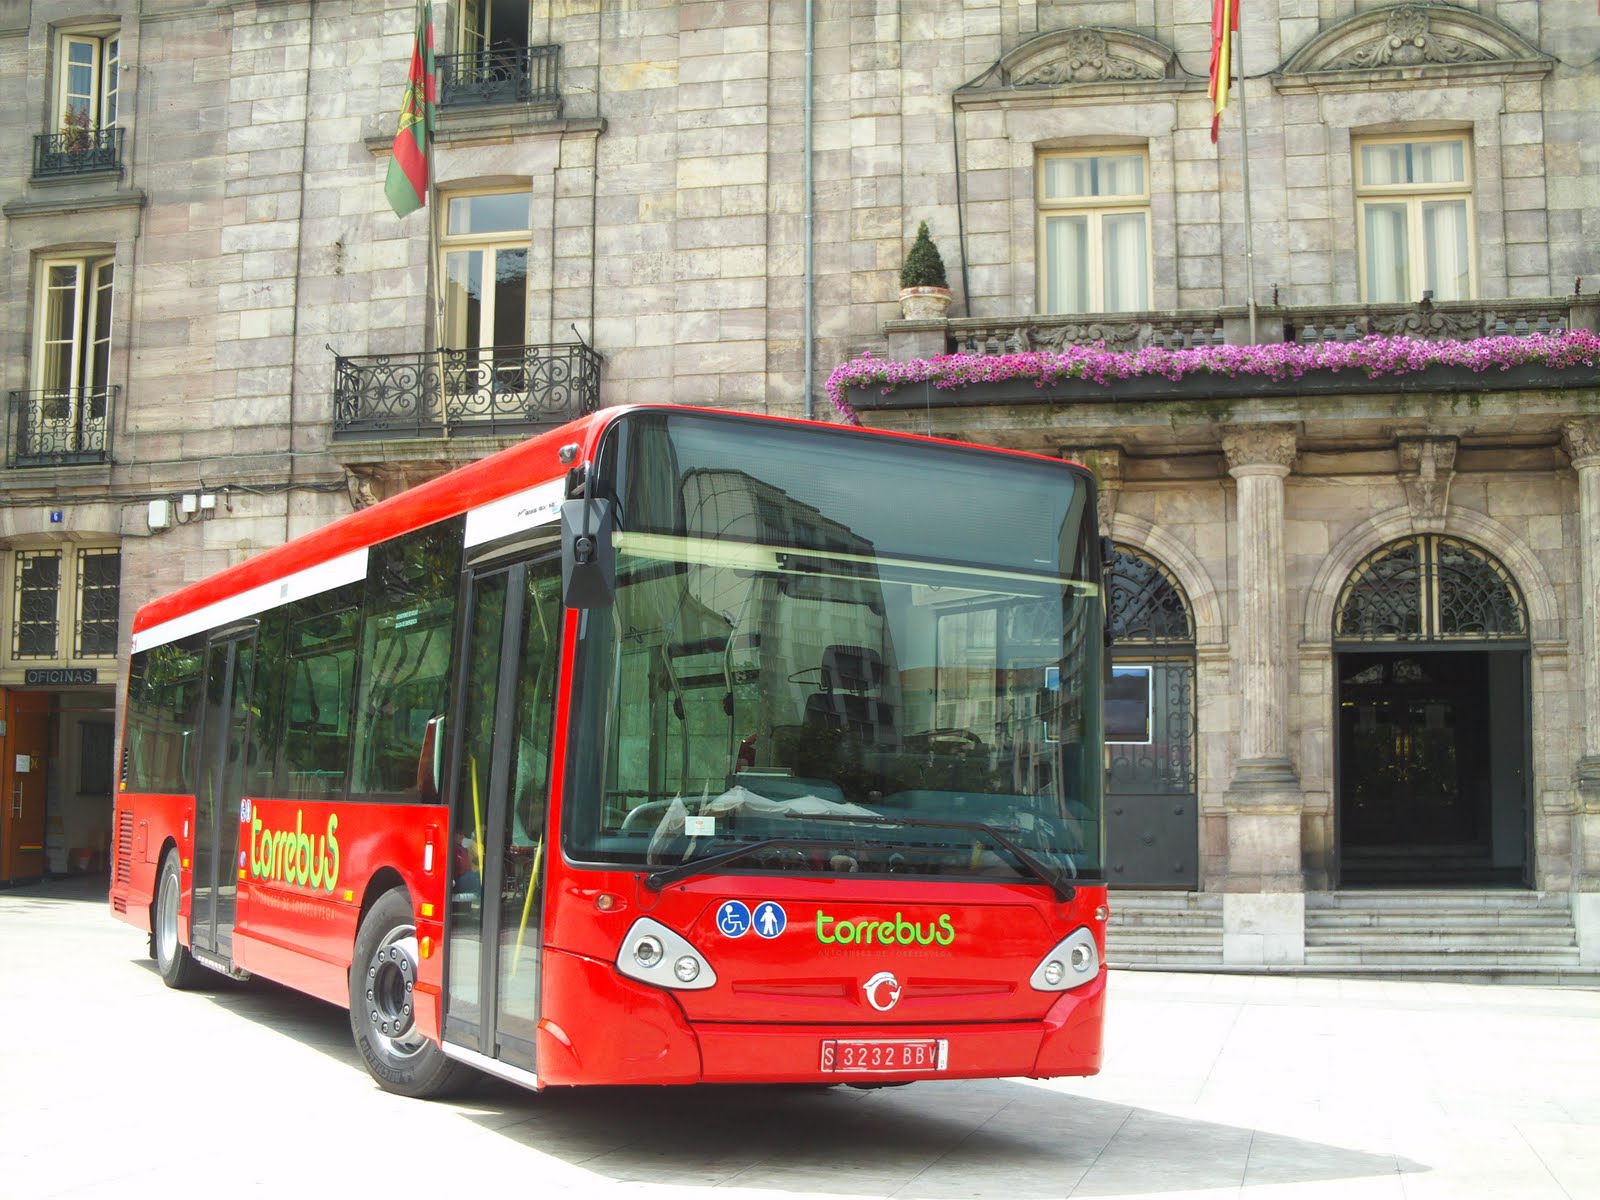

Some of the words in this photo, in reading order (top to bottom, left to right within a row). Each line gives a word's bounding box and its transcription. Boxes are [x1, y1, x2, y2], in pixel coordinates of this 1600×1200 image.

[27, 670, 92, 683] OFICINAS
[824, 1047, 834, 1066] S
[843, 1047, 895, 1066] 3232
[903, 1046, 936, 1065] BBV
